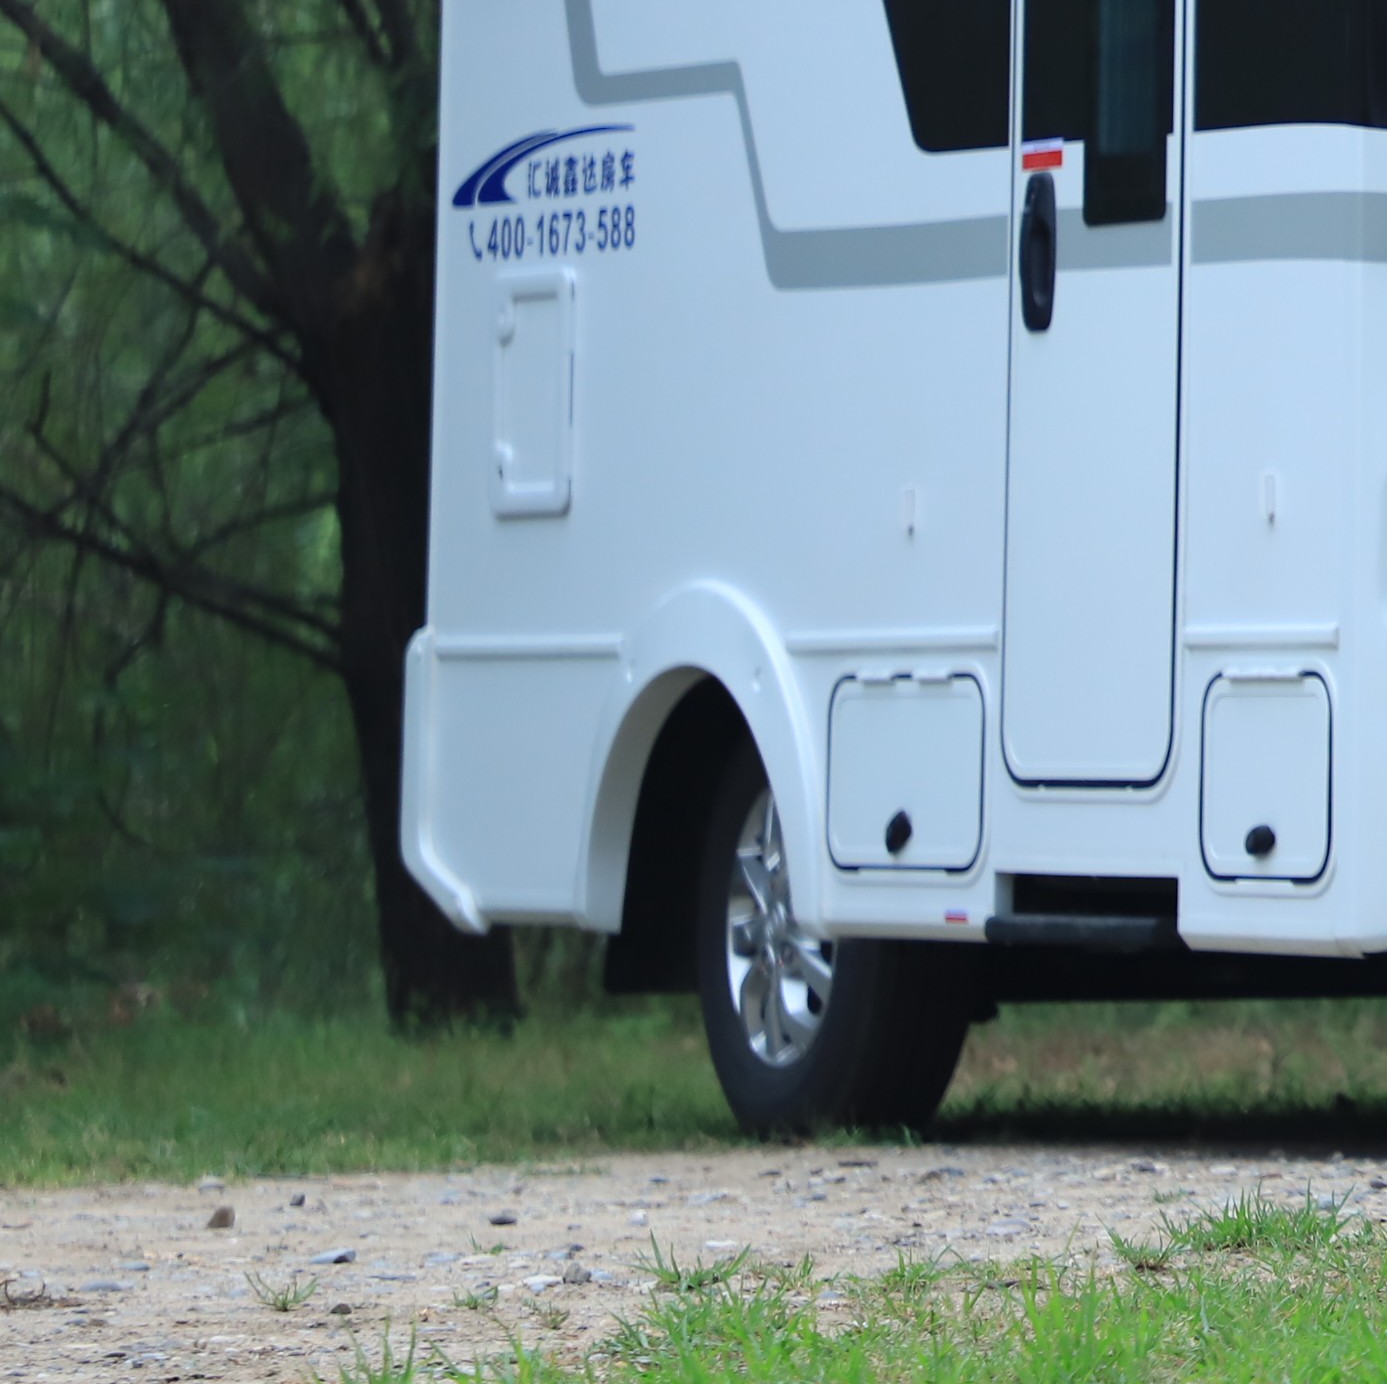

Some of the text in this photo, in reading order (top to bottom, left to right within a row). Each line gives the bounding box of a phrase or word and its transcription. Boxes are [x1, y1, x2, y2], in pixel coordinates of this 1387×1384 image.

[527, 148, 636, 200] 汇诚鑫达房车
[486, 204, 637, 262] 400-1673-588
